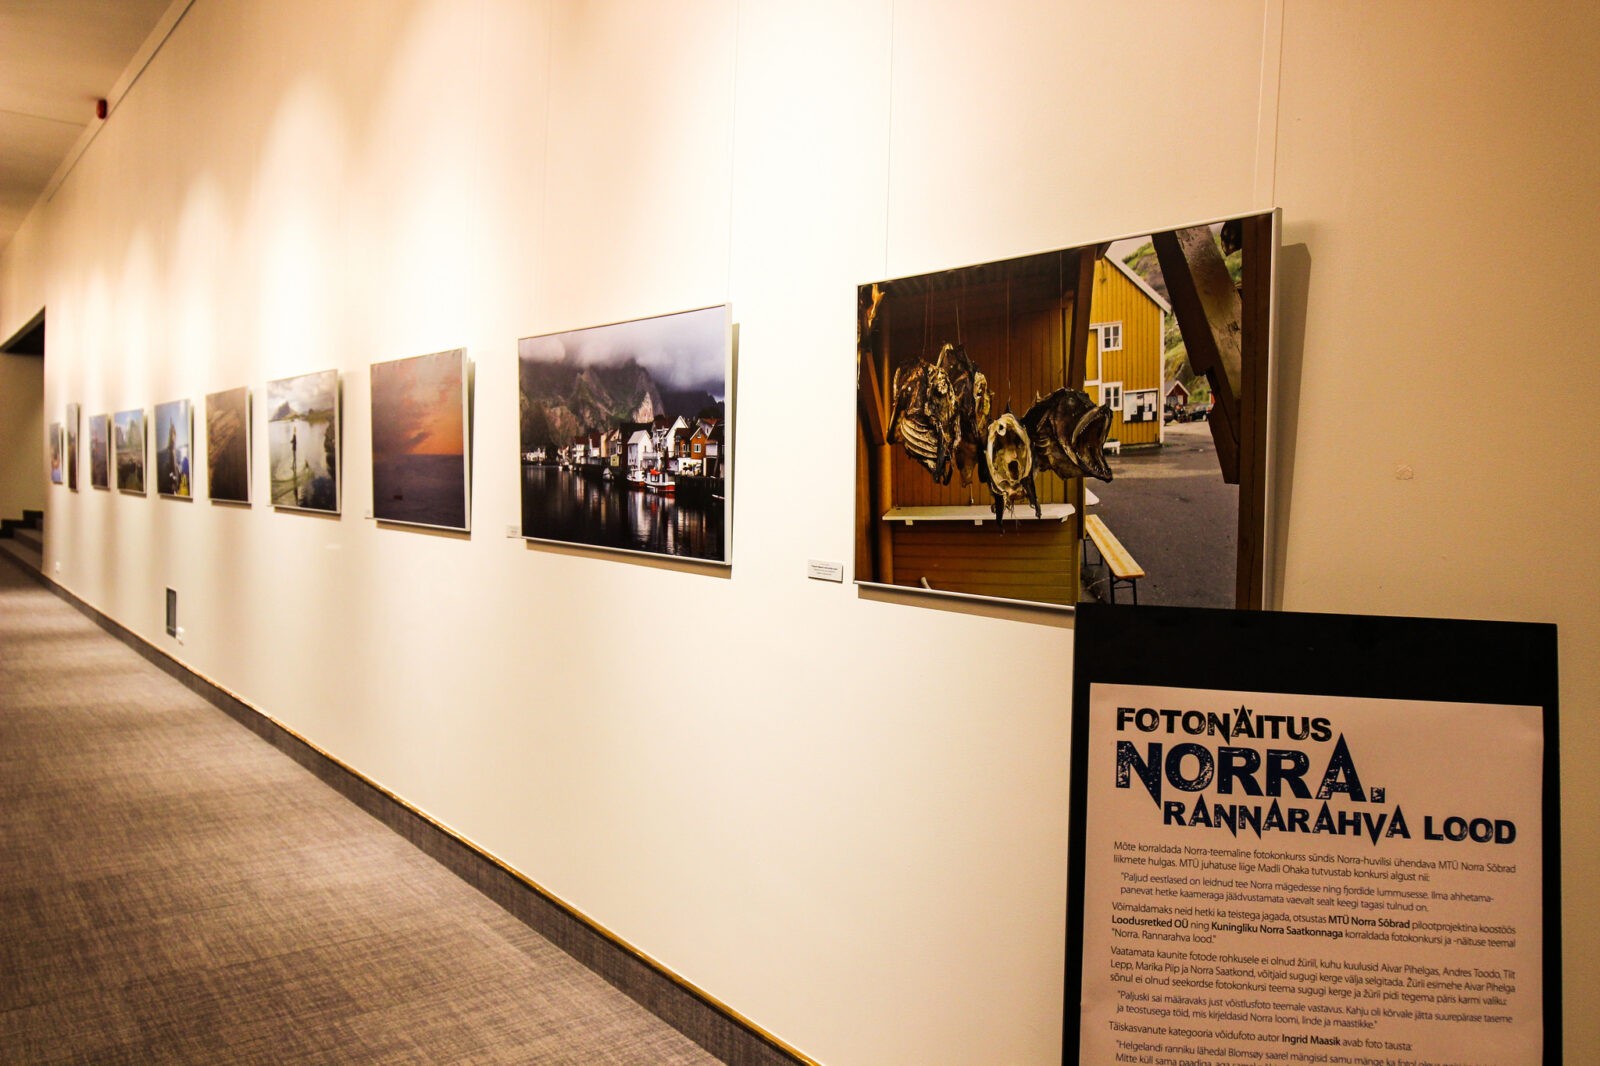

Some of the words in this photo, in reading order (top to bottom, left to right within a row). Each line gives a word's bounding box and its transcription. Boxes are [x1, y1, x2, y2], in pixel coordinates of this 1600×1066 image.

[1116, 705, 1332, 745] FOTONÄITUS
[1115, 733, 1386, 810] NORRA.
[1163, 794, 1411, 846] RANNARAHVA
[1424, 816, 1516, 845] LOOD
[1114, 855, 1145, 865] liikmete
[1201, 860, 1236, 870] juhatuse
[1239, 863, 1256, 873] liige
[1258, 864, 1280, 873] Madli
[1283, 865, 1309, 874] Ohaka
[1312, 868, 1351, 877] tutvustab
[1354, 869, 1388, 880] konkursi
[1391, 871, 1415, 882] algust
[1139, 843, 1181, 853] korraldada
[1184, 846, 1251, 858] Norra-teemaline
[1254, 849, 1305, 861] fotokonkurss
[1309, 853, 1335, 863] sündis
[1338, 855, 1392, 867] Norra-huvilisi
[1461, 862, 1484, 872] Norra
[1121, 872, 1148, 883] "Paljud
[1150, 875, 1187, 885] eestlased
[1203, 877, 1233, 887] leidnud
[1235, 880, 1248, 888] tee
[1251, 881, 1272, 890] Norra
[1275, 884, 1320, 893] mägedesse
[1323, 886, 1341, 896] ning
[1344, 886, 1374, 897] fjordide
[1431, 892, 1448, 900] Ilma
[1121, 887, 1153, 896] panevat
[1155, 887, 1178, 897] hetke
[1180, 889, 1224, 900] kaameraga
[1226, 892, 1284, 903] jäädvustamata
[1286, 896, 1314, 905] vaevalt
[1317, 897, 1335, 905] sealt
[1337, 897, 1358, 909] keegi
[1361, 901, 1384, 911] tagasi
[1387, 901, 1413, 911] tulnud
[1416, 904, 1428, 912] on.
[1112, 901, 1172, 915] Võimaldamaks
[1175, 906, 1192, 915] neid
[1195, 907, 1214, 917] hetki
[1217, 909, 1226, 917] ka
[1228, 910, 1260, 922] teistega
[1293, 915, 1326, 923] otsustas
[1351, 916, 1376, 926] Norra
[1412, 921, 1477, 932] pilootprojektina
[1479, 923, 1516, 934] koostöös
[1112, 915, 1172, 927] Loodusretked
[1175, 918, 1188, 928] OÜ
[1191, 921, 1209, 931] ning
[1212, 922, 1258, 933] Kuningliku
[1260, 925, 1284, 934] Norra
[1287, 926, 1343, 939] Saatkonnaga
[1345, 930, 1389, 941] korraldada
[1392, 932, 1442, 944] fotokonkursi
[1444, 936, 1451, 945] ja
[1488, 938, 1515, 948] teemal
[1112, 928, 1139, 939] "Norra.
[1142, 930, 1190, 942] Rannarahva
[1111, 948, 1154, 958] Vaatamata
[1157, 950, 1187, 959] kaunite
[1189, 952, 1217, 961] fotode
[1220, 954, 1258, 964] rohkusele
[1261, 956, 1269, 964] ei
[1271, 956, 1295, 966] olnud
[1320, 960, 1341, 969] kuhu
[1344, 961, 1378, 972] kuulusid
[1382, 964, 1402, 973] Aivar
[1443, 967, 1472, 977] Andres
[1111, 960, 1133, 971] Lepp,
[1136, 961, 1162, 972] Marika
[1165, 963, 1179, 974] Piip
[1182, 966, 1188, 974] ja
[1191, 966, 1213, 975] Norra
[1216, 967, 1255, 978] Saatkond,
[1258, 970, 1287, 981] võitjaid
[1290, 974, 1317, 983] sugugi
[1320, 973, 1342, 984] kerge
[1344, 976, 1363, 985] välja
[1426, 980, 1462, 991] esimehe
[1465, 982, 1484, 992] Aivar
[1110, 973, 1133, 983] sõnul
[1135, 975, 1142, 984] ei
[1145, 976, 1169, 986] olnud
[1172, 979, 1213, 988] seekordse
[1216, 981, 1266, 992] fotokonkursi
[1269, 984, 1295, 993] teema
[1298, 987, 1326, 996] sugugi
[1328, 987, 1352, 998] kerge
[1354, 990, 1361, 999] ja
[1383, 992, 1399, 1000] pidi
[1402, 993, 1434, 1003] tegema
[1437, 995, 1456, 1005] päris
[1458, 996, 1480, 1004] karmi
[1117, 1004, 1124, 1013] ja
[1126, 1006, 1171, 1017] teostusega
[1173, 1008, 1190, 1018] töid,
[1193, 1010, 1207, 1018] mis
[1209, 1009, 1248, 1021] kirjeldasid
[1250, 1013, 1272, 1023] Norra
[1302, 1016, 1322, 1026] linde
[1323, 1018, 1331, 1028] ja
[1118, 991, 1149, 1002] "Paljuski
[1152, 994, 1162, 1002] sai
[1226, 998, 1271, 1009] võistlusfoto
[1273, 1002, 1305, 1011] teemale
[1346, 1006, 1369, 1016] Kahju
[1371, 1007, 1381, 1016] oli
[1383, 1008, 1413, 1019] kõrvale
[1415, 1011, 1433, 1020] jätta
[1435, 1013, 1482, 1022] suurepärase
[1109, 1021, 1166, 1034] Täiskasvanute
[1169, 1027, 1212, 1038] kategooria
[1215, 1029, 1255, 1040] võidufoto
[1258, 1033, 1279, 1042] autor
[1282, 1034, 1308, 1045] Ingrid
[1311, 1036, 1340, 1046] Maasik
[1343, 1037, 1363, 1047] avab
[1365, 1038, 1383, 1050] foto
[1115, 1052, 1138, 1063] Mitte
[1165, 1044, 1194, 1054] ranniku
[1197, 1045, 1226, 1056] lähedal
[1265, 1051, 1288, 1060] saarel
[1291, 1052, 1327, 1063] mängisid
